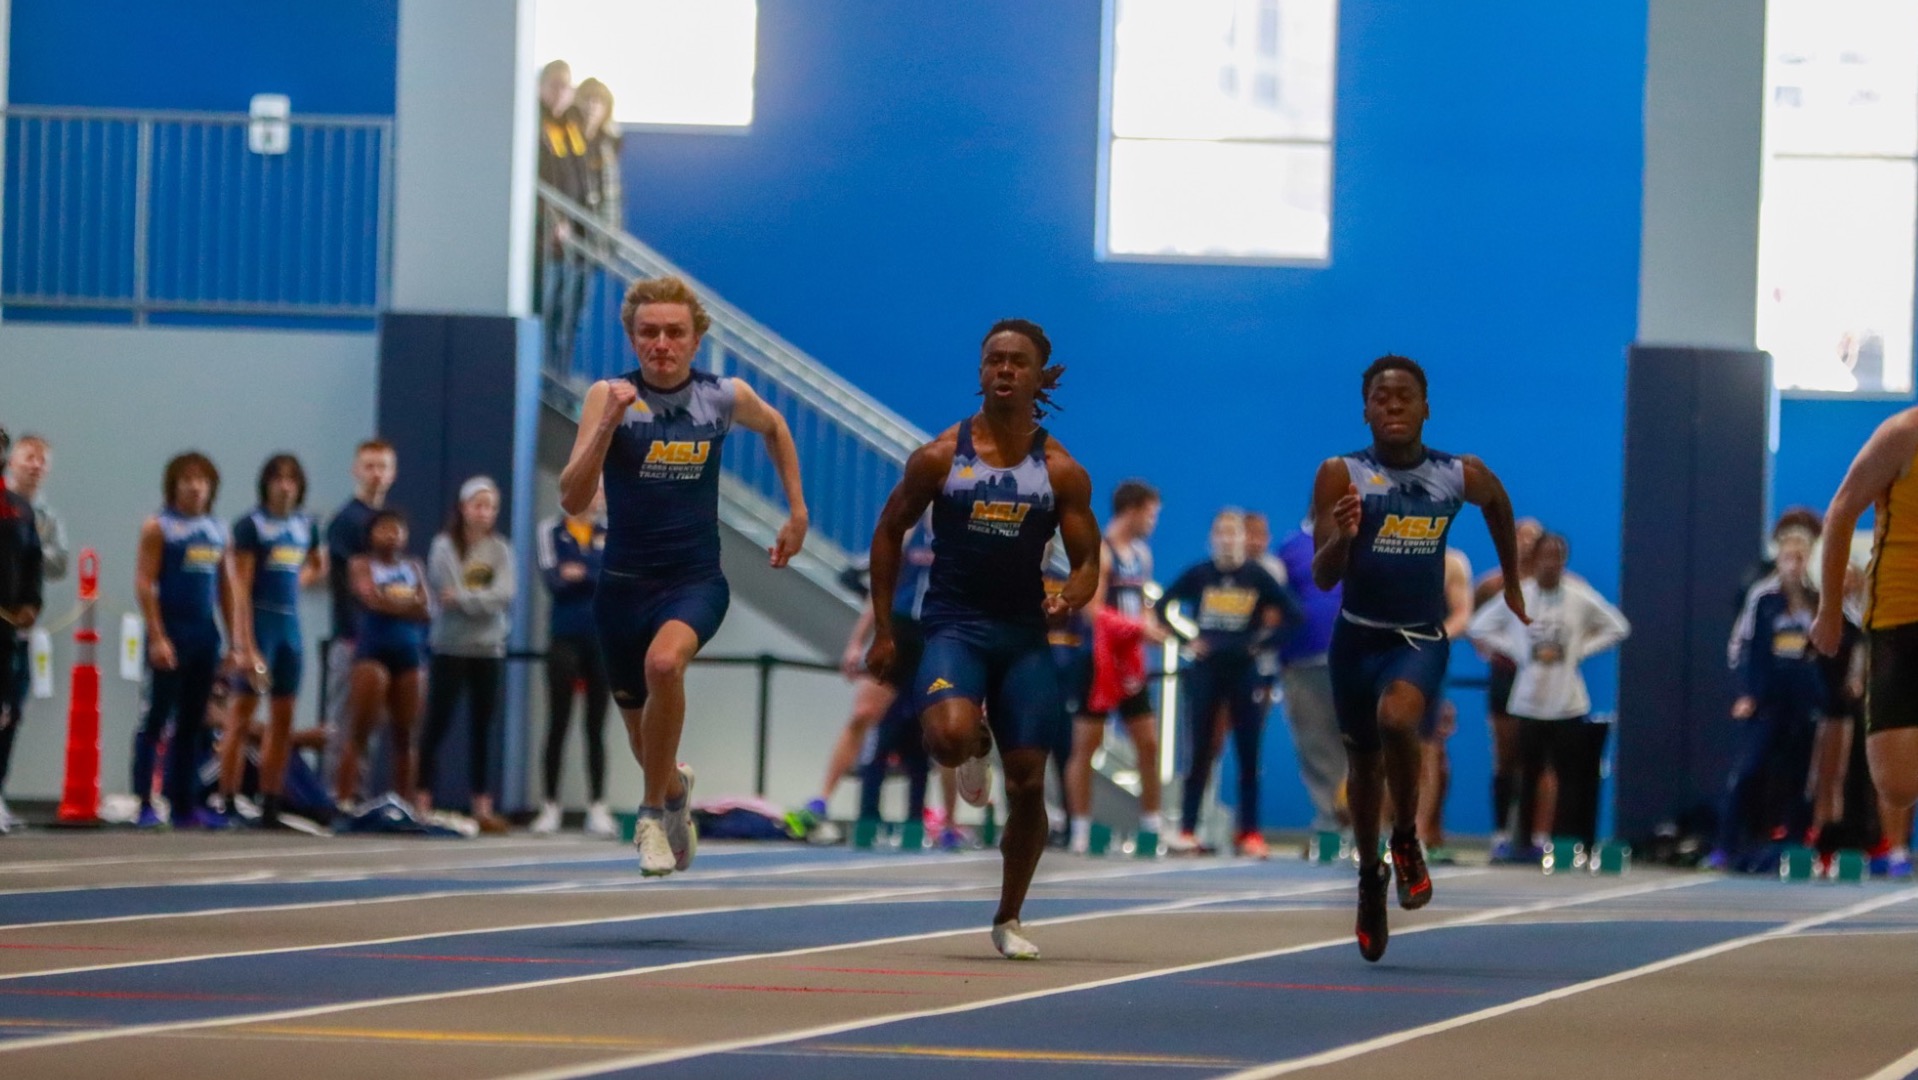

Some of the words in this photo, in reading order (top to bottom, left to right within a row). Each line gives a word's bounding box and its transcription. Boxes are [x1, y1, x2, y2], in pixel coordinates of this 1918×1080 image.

[644, 440, 710, 464] MSJ
[970, 500, 1031, 522] MSJ
[1378, 514, 1448, 539] MSJ
[1372, 545, 1402, 554] TRACK
